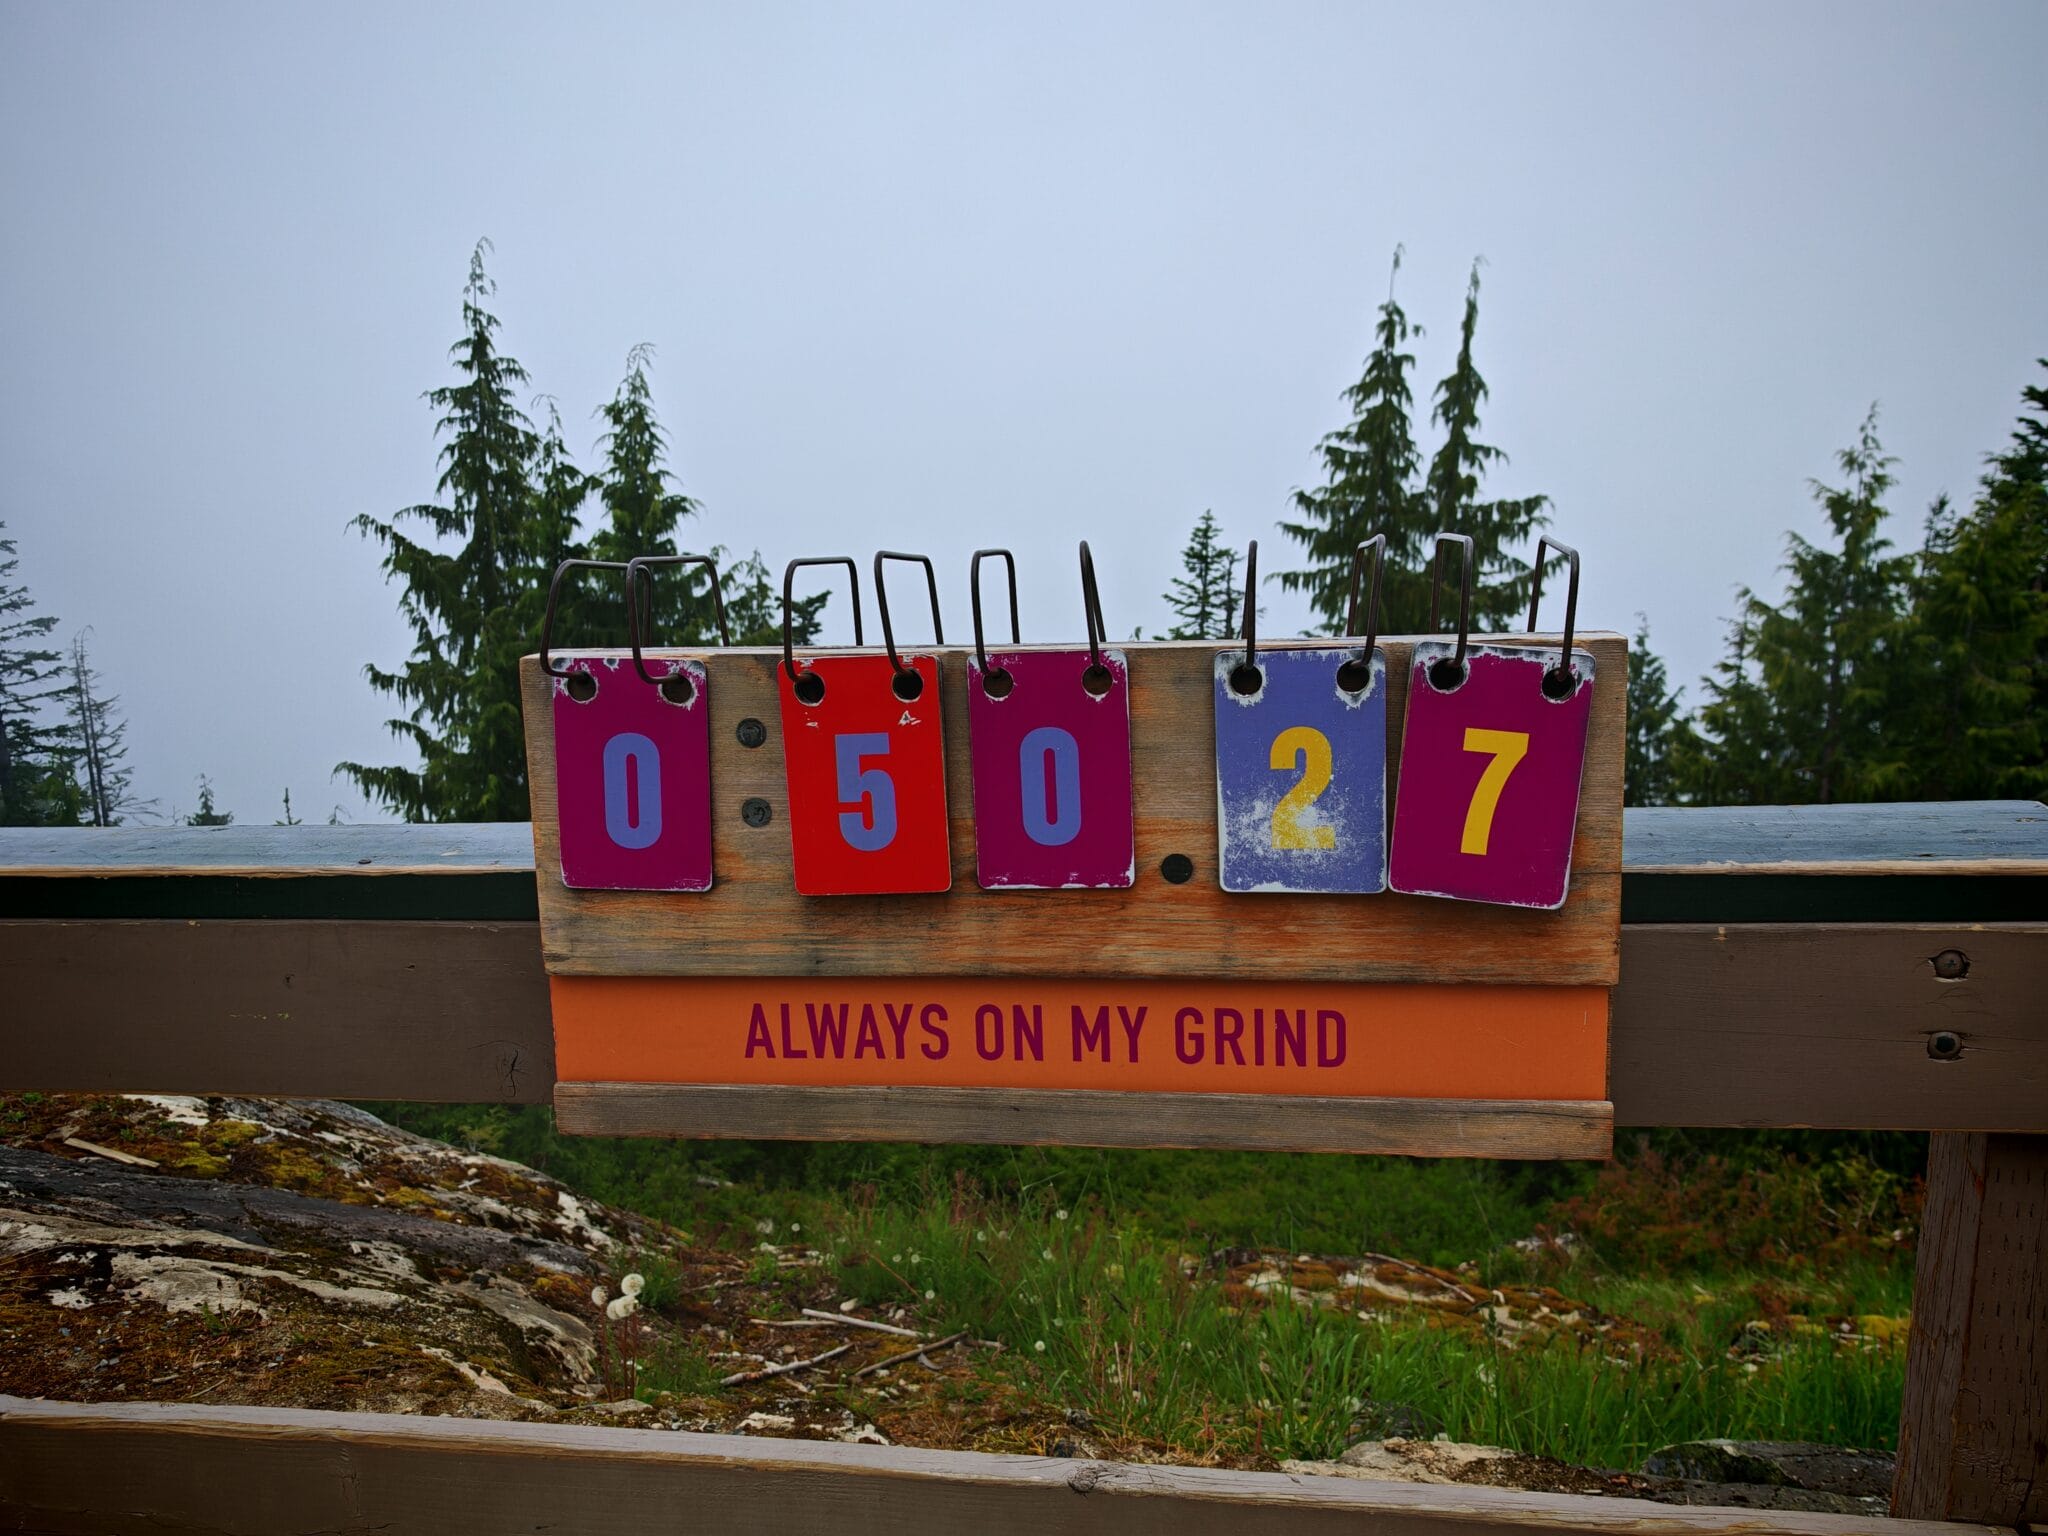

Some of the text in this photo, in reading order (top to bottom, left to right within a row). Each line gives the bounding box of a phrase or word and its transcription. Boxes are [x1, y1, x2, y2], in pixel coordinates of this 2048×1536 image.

[603, 726, 1529, 856] 0 5 0 2 7
[745, 1002, 1348, 1068] ALWAYS ON MY GRIND
